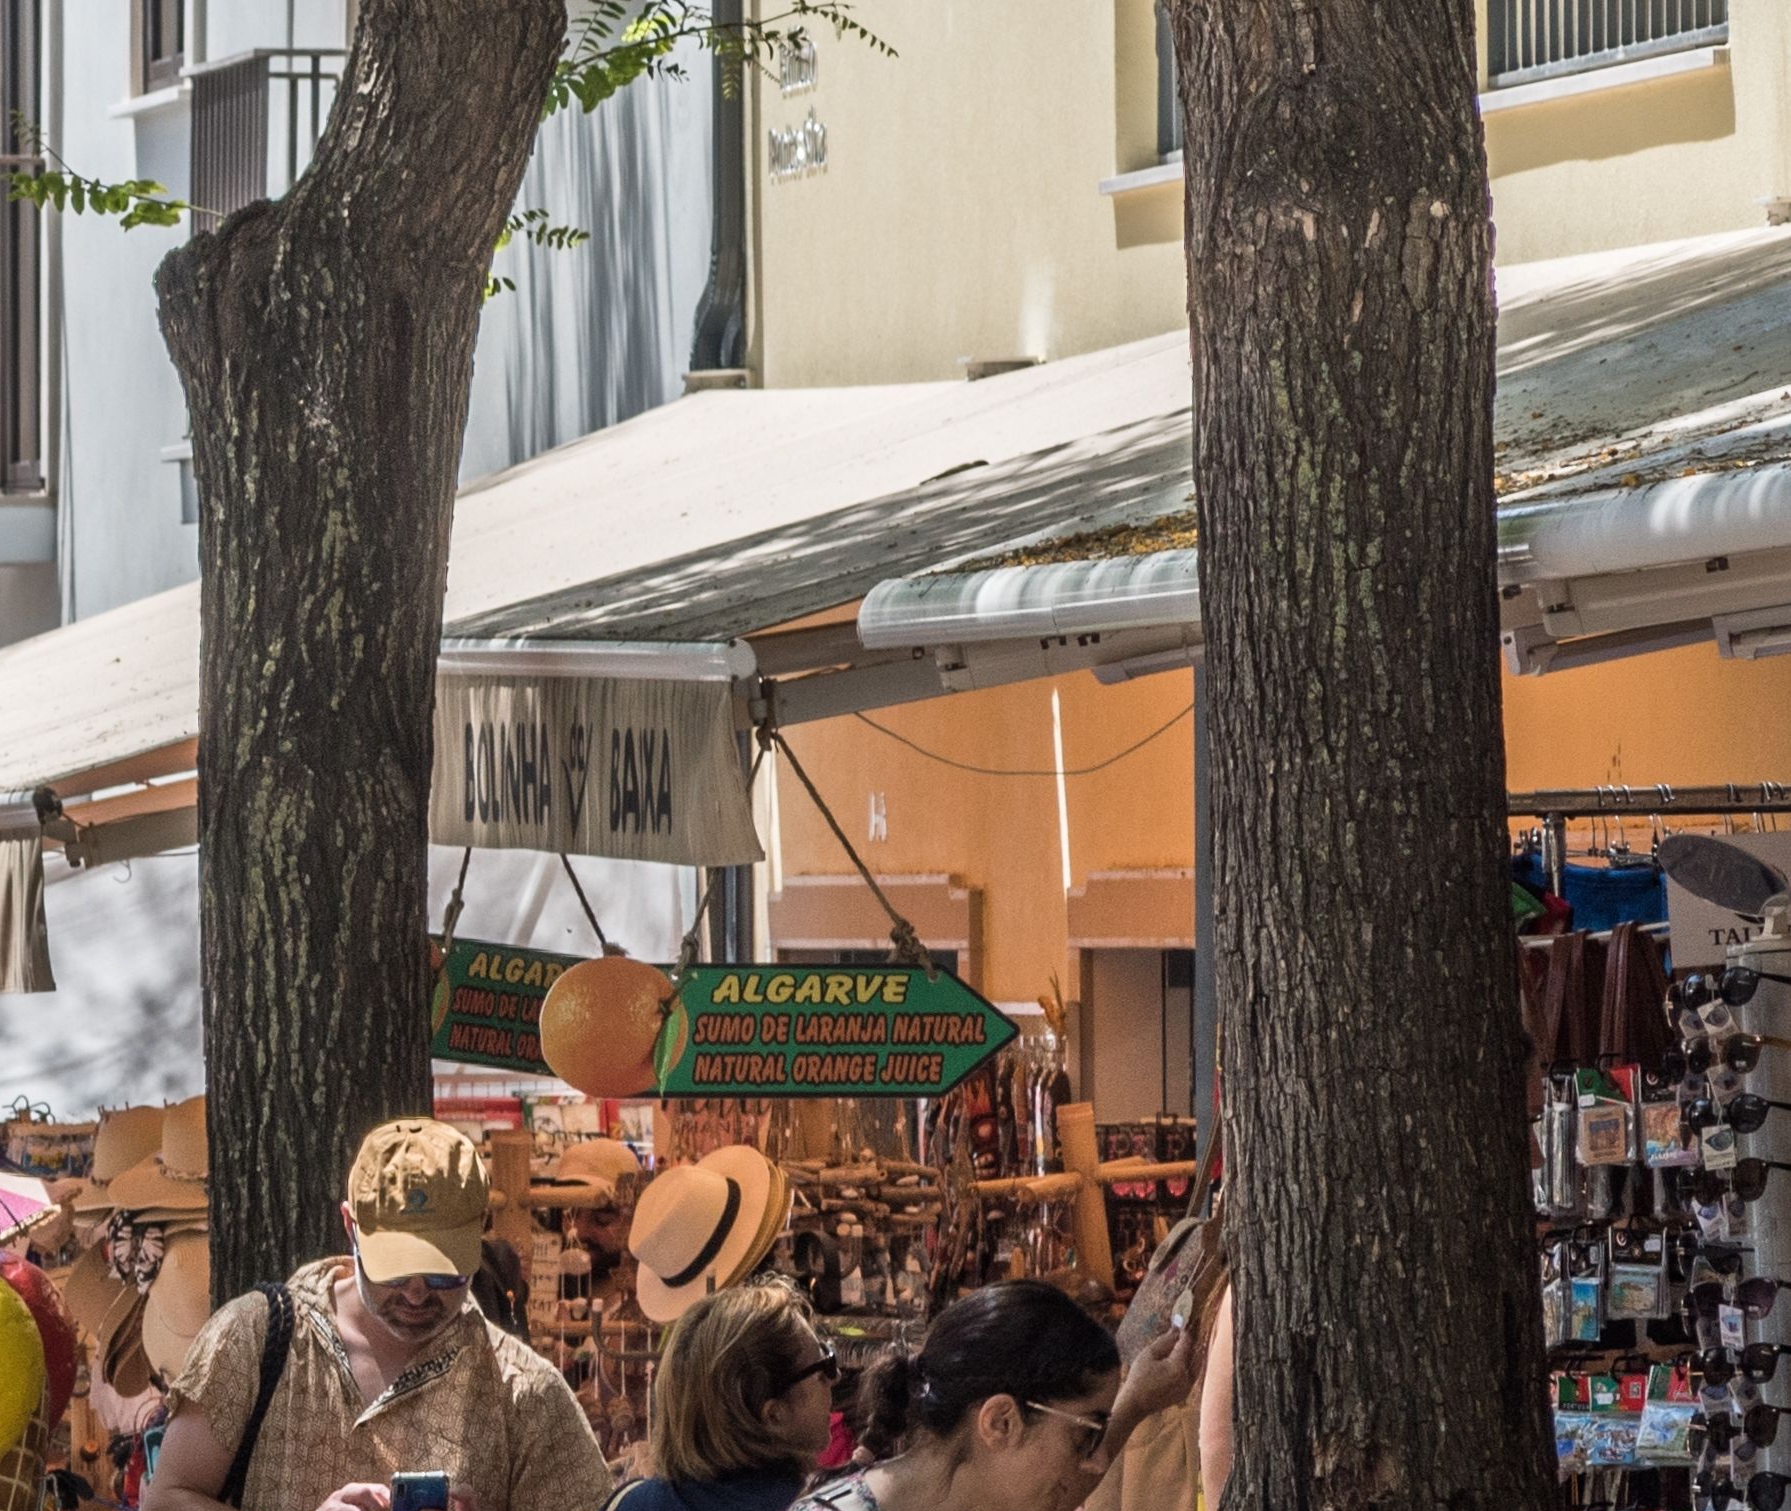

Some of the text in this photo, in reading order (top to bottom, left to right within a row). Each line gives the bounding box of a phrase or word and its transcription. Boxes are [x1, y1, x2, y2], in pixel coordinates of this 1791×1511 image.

[469, 951, 567, 990] ALGAR
[452, 985, 496, 1018] SUMO
[497, 993, 518, 1021] DE
[712, 974, 909, 1006] ALGARVE
[448, 1022, 513, 1056] NATURAL
[693, 1013, 987, 1044] SUMO DE LARANJA NATURAL
[693, 1053, 943, 1084] NATURAL ORANGE JUICE
